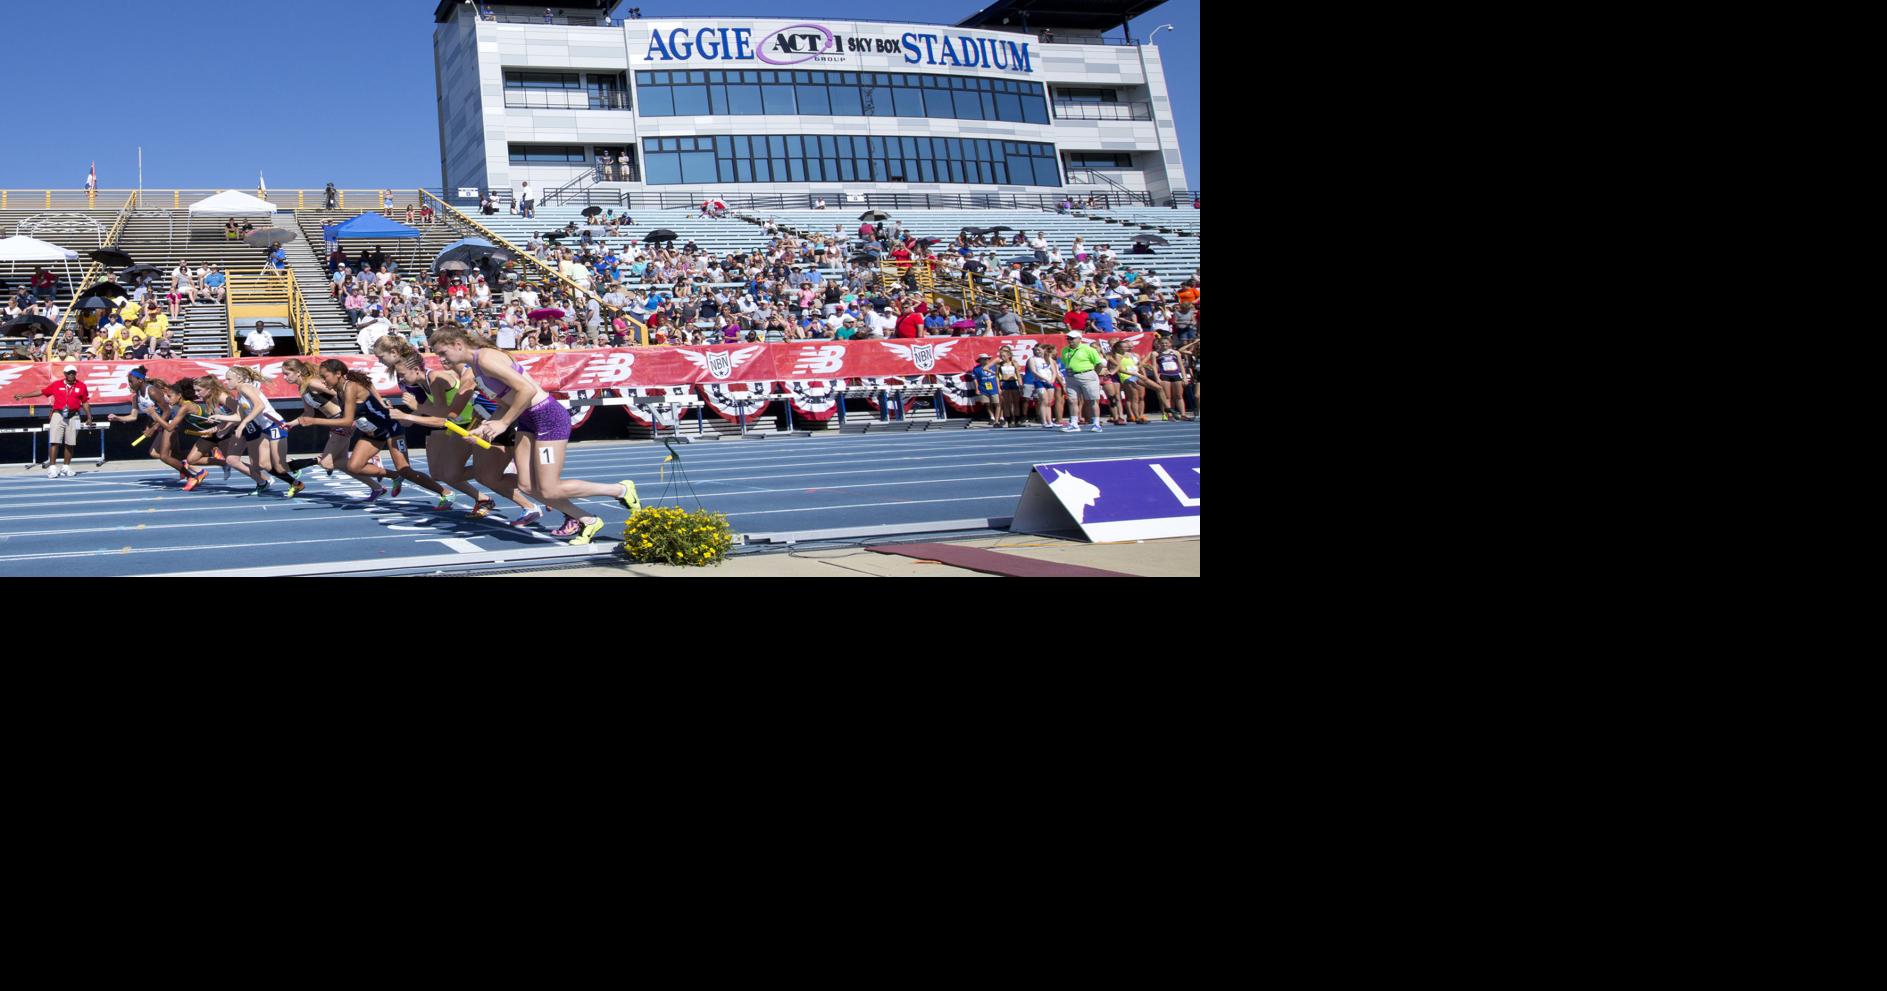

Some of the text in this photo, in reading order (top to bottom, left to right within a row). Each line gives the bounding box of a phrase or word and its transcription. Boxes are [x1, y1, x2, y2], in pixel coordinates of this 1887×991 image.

[644, 28, 754, 60] AGGIE
[772, 33, 821, 54] ACT
[848, 37, 901, 54] SKY BOX
[901, 32, 1033, 73] STADIUM
[577, 353, 634, 384] NB
[709, 356, 729, 371] NBN
[792, 345, 846, 374] NB
[914, 349, 932, 363] NBN
[543, 447, 550, 463] 1
[1149, 463, 1200, 507] L
